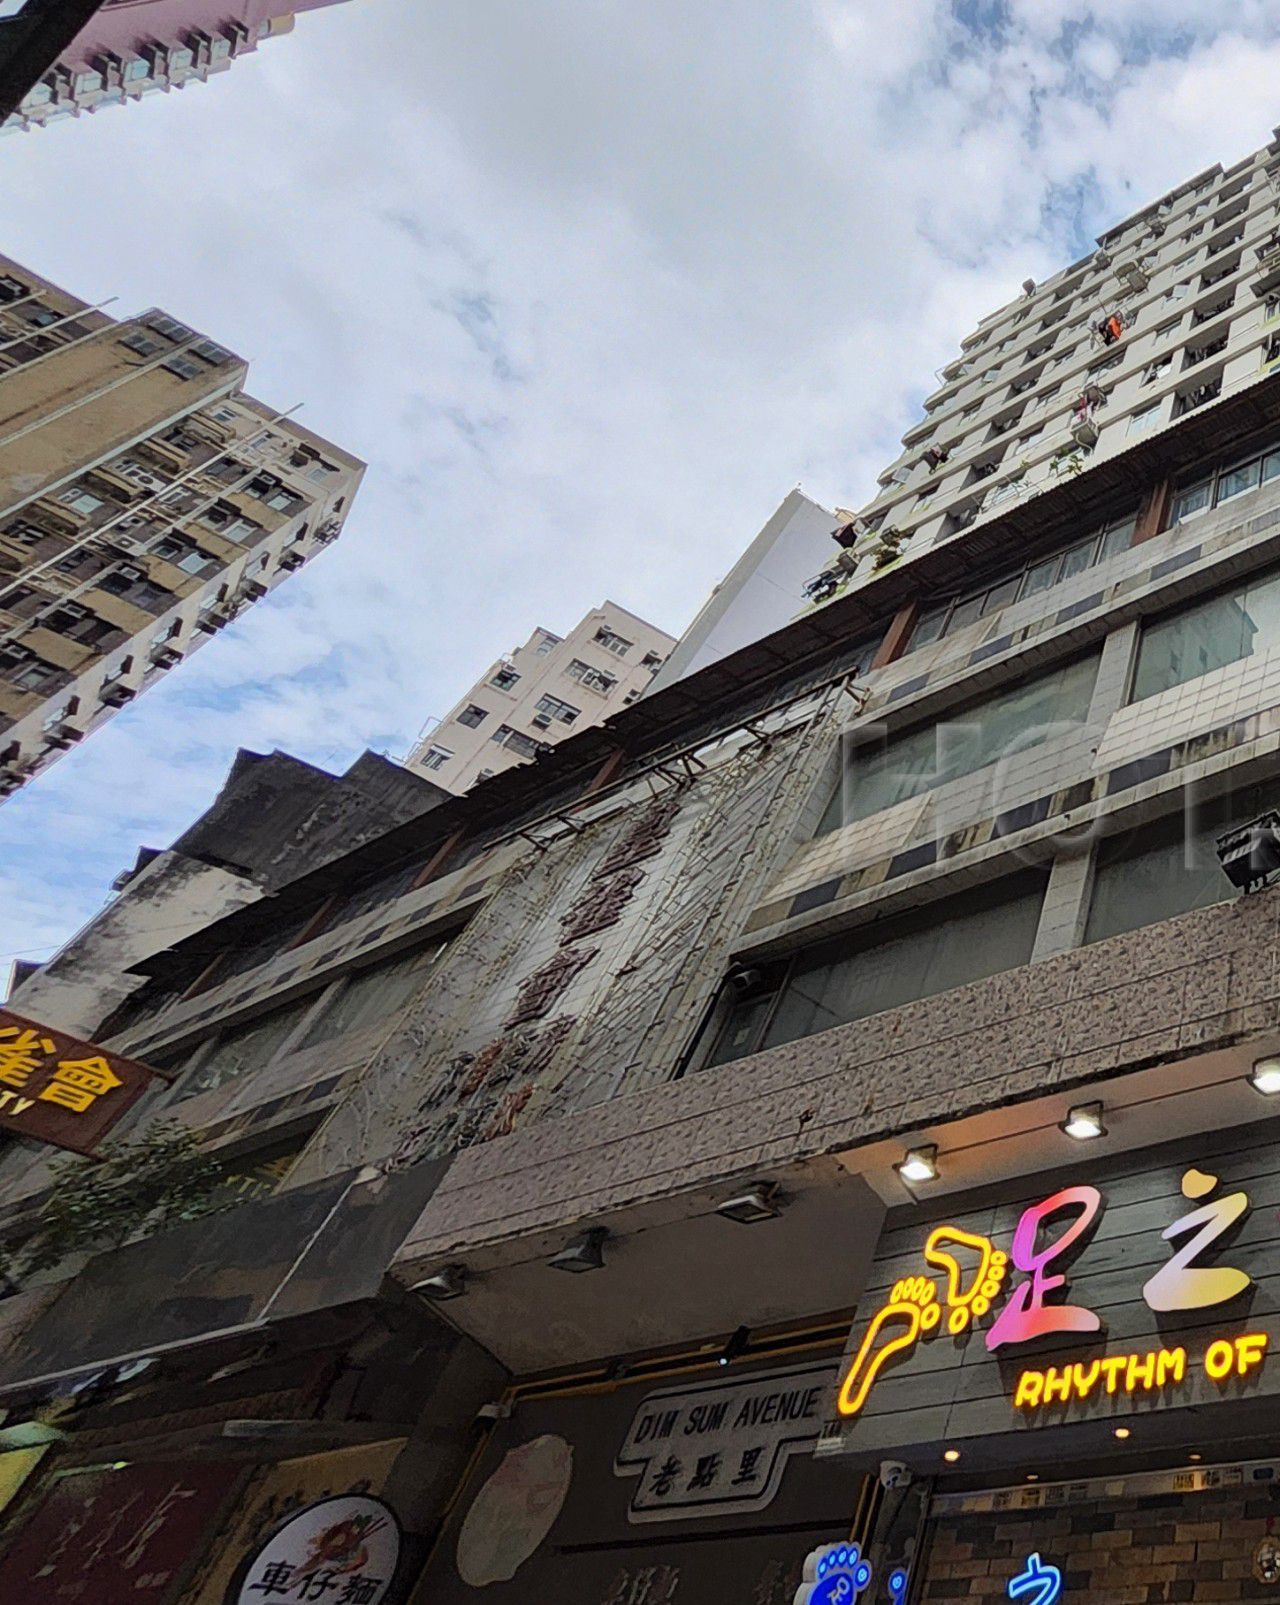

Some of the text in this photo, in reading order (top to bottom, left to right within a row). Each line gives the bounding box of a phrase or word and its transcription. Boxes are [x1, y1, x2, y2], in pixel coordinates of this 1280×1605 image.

[1015, 1347, 1186, 1407] RHYTHM
[1204, 1333, 1267, 1379] OF
[634, 1386, 822, 1443] DIM SUM AVENUE
